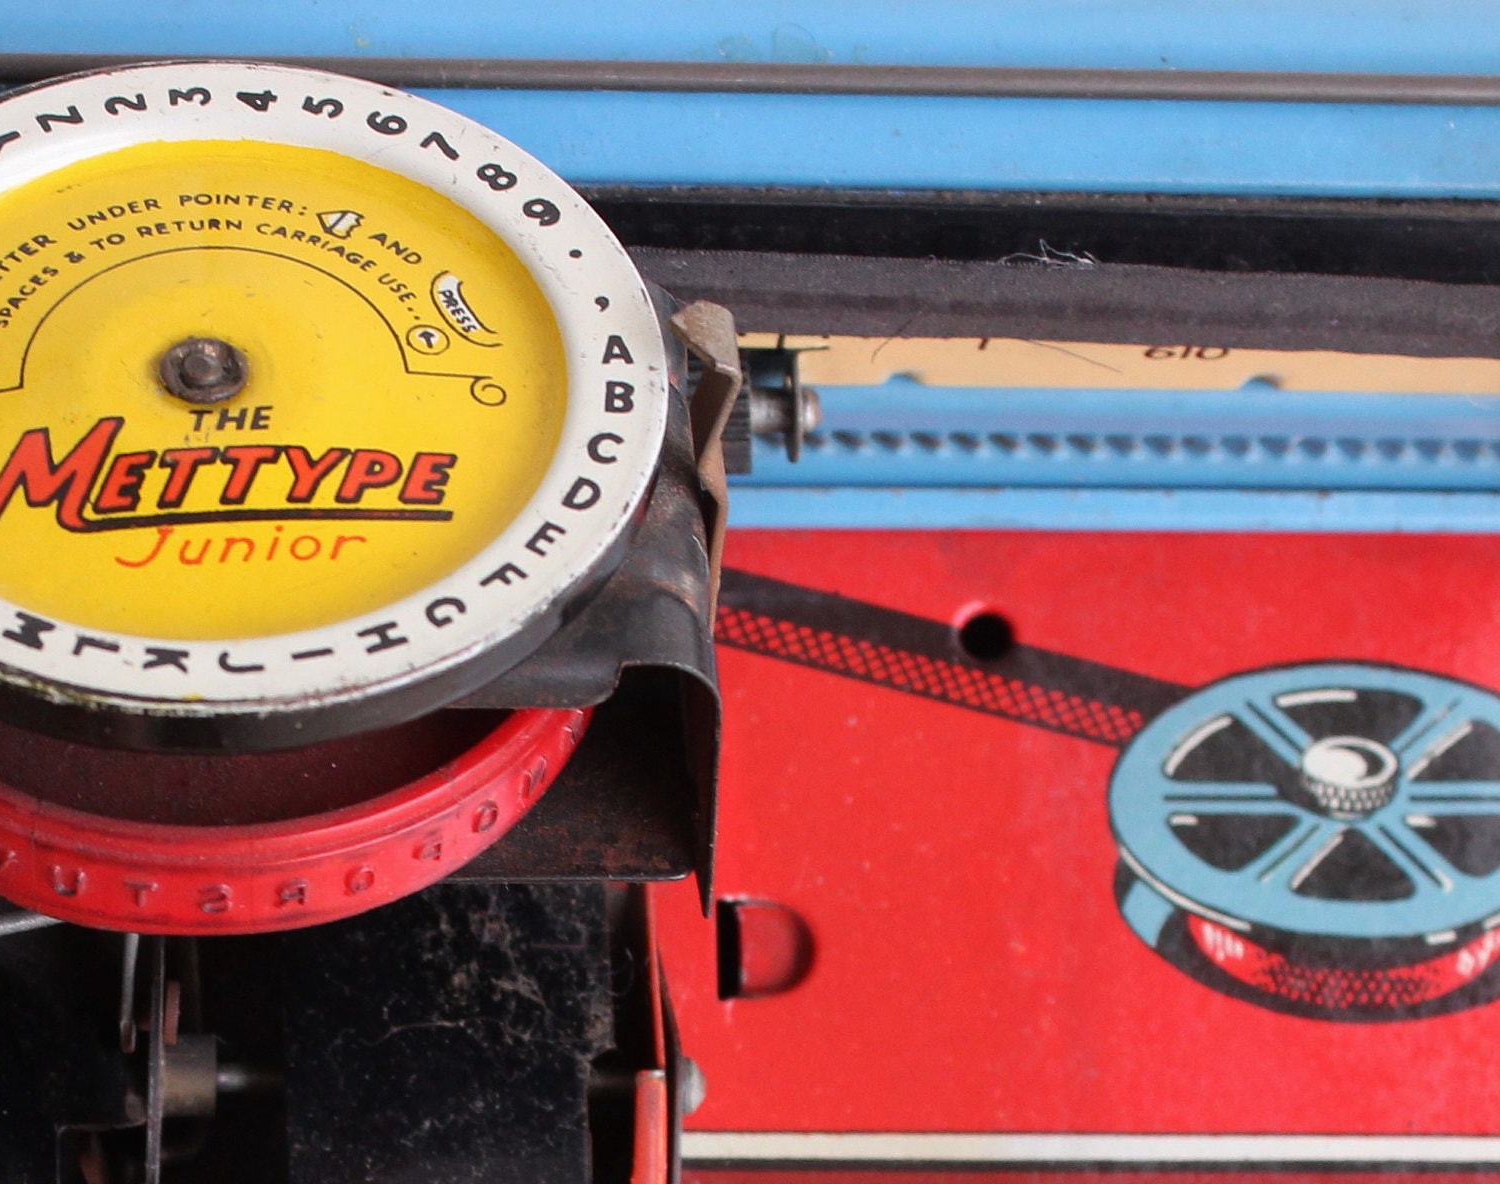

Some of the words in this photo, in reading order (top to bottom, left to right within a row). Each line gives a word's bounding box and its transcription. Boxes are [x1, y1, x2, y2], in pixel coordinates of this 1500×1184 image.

[105, 94, 147, 115] 2
[169, 87, 211, 105] 3
[236, 91, 277, 111] 4
[302, 97, 343, 118] 5
[36, 106, 83, 132] Z
[367, 111, 407, 135] 6
[420, 132, 459, 160] 7
[477, 164, 517, 191] 8
[523, 199, 560, 226] 9
[67, 199, 162, 230] UNDER
[179, 194, 308, 216] POINTER:
[369, 232, 423, 266] AND
[64, 251, 86, 264] &
[89, 233, 126, 250] TO
[136, 219, 243, 238] RETURN
[256, 223, 377, 272] CARRIAGE
[438, 289, 481, 334] PRESS
[602, 335, 633, 364] A
[605, 381, 634, 413] B
[188, 406, 274, 432] THE
[587, 433, 624, 464] C
[562, 477, 600, 510] D
[114, 525, 368, 569] Junior
[525, 522, 566, 556] E
[480, 563, 527, 586] F
[426, 598, 466, 627] G
[2, 612, 55, 650] M
[357, 622, 408, 654] H
[73, 636, 120, 655] L
[292, 648, 333, 660] I
[143, 648, 189, 673] K
[219, 652, 264, 673] J
